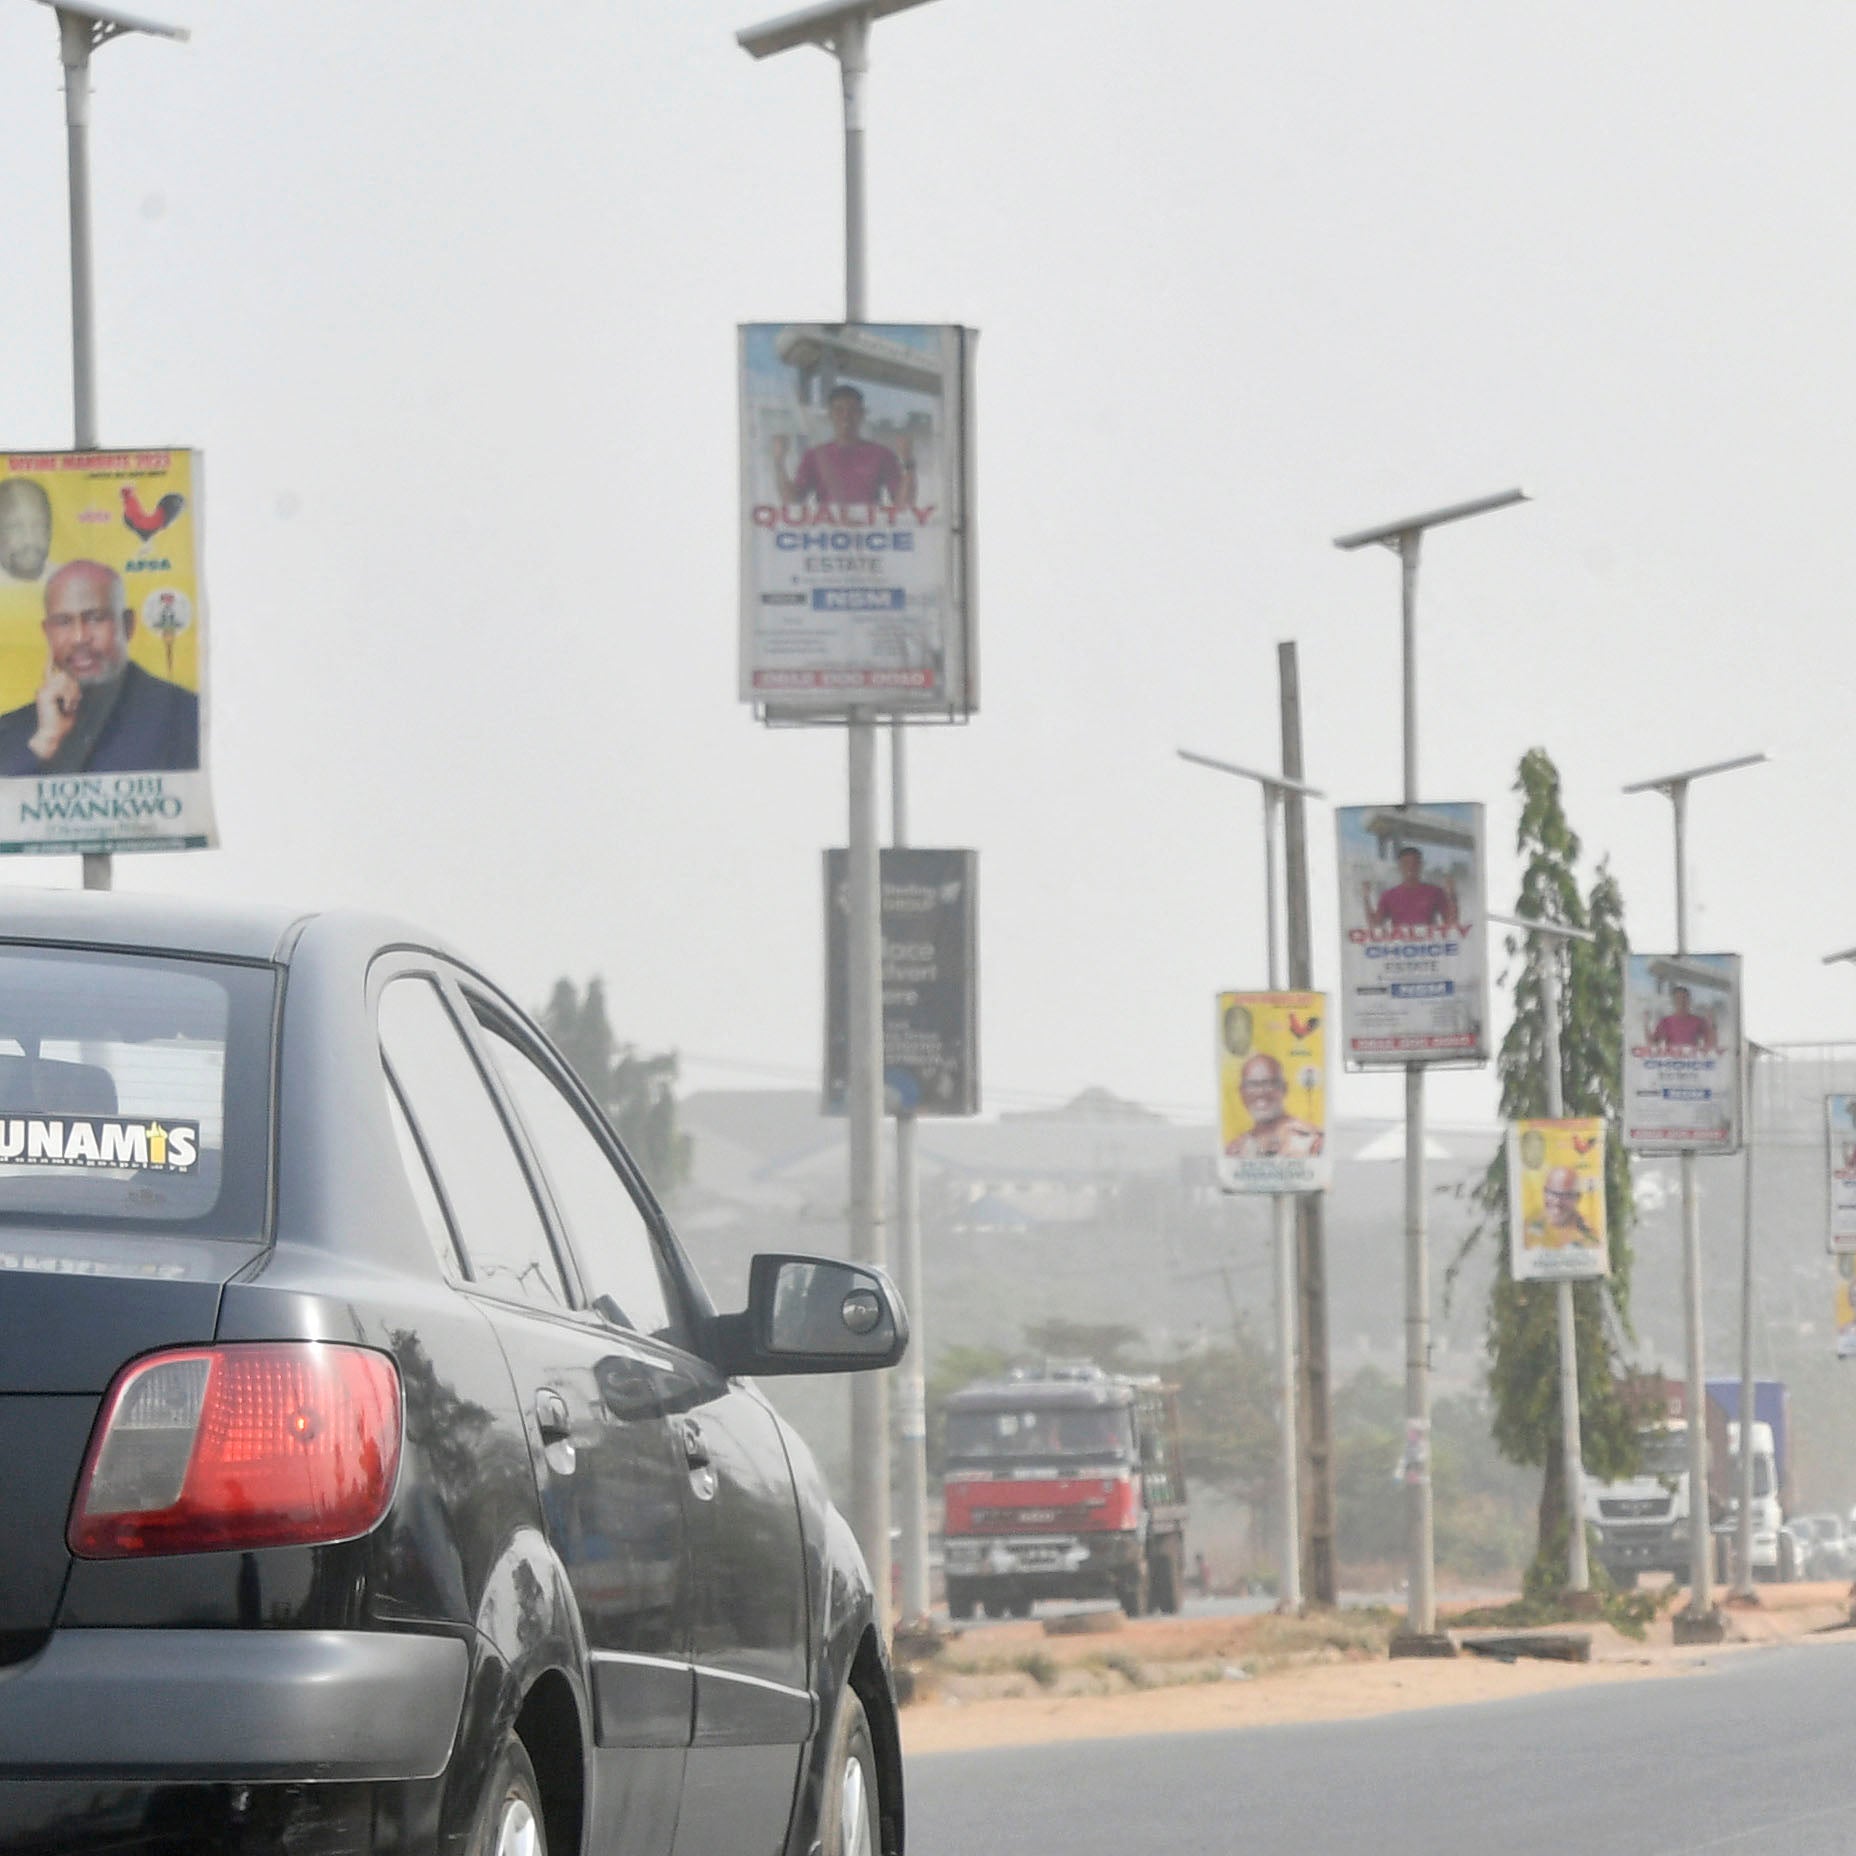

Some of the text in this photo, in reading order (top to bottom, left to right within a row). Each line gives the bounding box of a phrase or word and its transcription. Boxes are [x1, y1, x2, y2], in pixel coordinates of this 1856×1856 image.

[752, 505, 936, 530] QUALITY
[776, 532, 914, 551] CHOICE
[20, 797, 183, 823] NWANKWO
[1348, 924, 1473, 943] QUALITY
[1365, 943, 1459, 958] CHOICE
